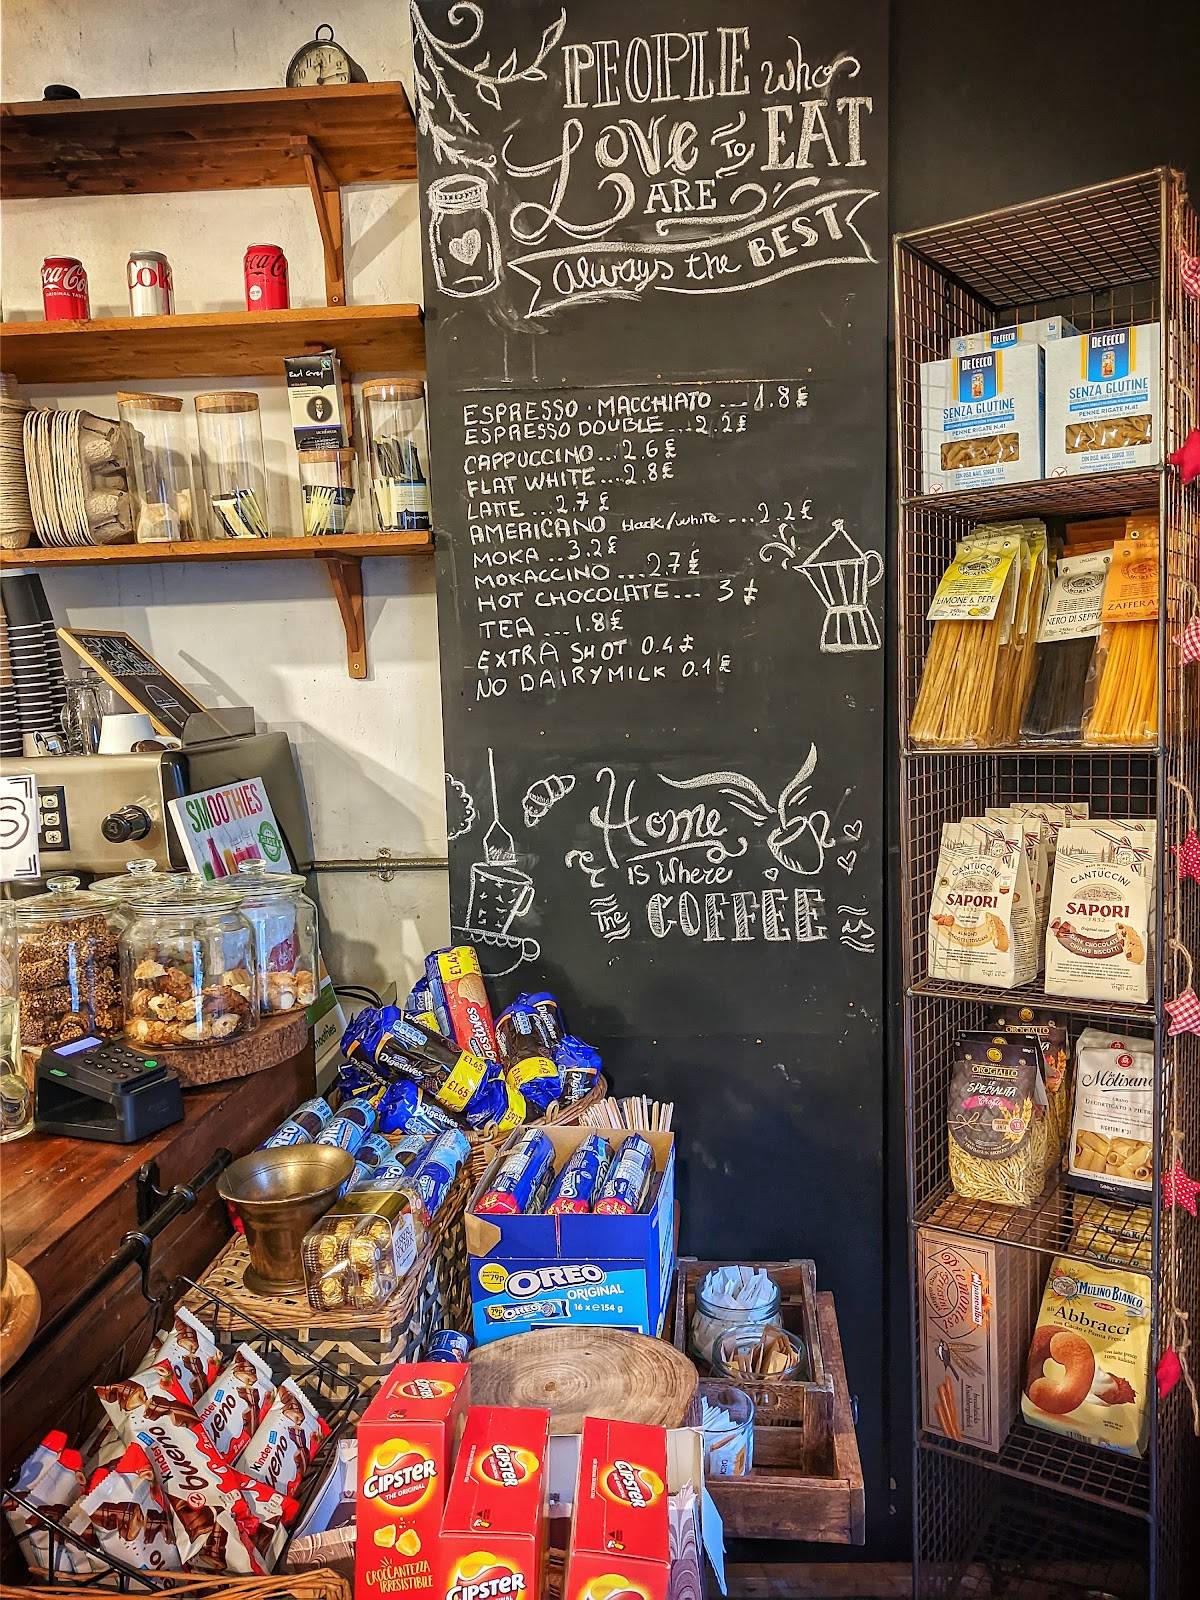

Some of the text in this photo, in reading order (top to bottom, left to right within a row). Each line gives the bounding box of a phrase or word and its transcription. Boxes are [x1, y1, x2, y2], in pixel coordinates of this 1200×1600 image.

[562, 26, 861, 109] PEOPLE who
[723, 138, 748, 159] TO
[760, 96, 873, 172] EAT
[643, 178, 717, 215] ARE
[683, 250, 742, 280] the
[746, 201, 844, 269] BEST
[1069, 384, 1102, 400] SENZA
[1106, 377, 1149, 394] GLUTINE
[463, 399, 579, 426] ESPRESSO
[598, 391, 712, 418] MACCHIATO
[943, 404, 973, 420] SENZA
[976, 397, 1015, 415] GLUTINE
[1101, 406, 1123, 414] RIGATE
[465, 421, 571, 446] ESPRESSO
[578, 415, 665, 437] DOUBLE
[972, 425, 992, 434] RIGATE
[463, 445, 595, 476] CAPPUCCINO
[466, 475, 518, 498] FLAT
[524, 466, 596, 491] WHITE
[469, 515, 606, 546] AMERICANO
[473, 547, 540, 569] MOKA
[474, 564, 610, 590] MOKACCINO
[478, 592, 524, 612] HOT
[535, 583, 669, 607] CHOCOLATE
[937, 596, 968, 605] LIMONE
[1107, 600, 1156, 611] ZAFFERA
[478, 617, 536, 639] TEA
[1046, 616, 1067, 626] NERO
[1068, 614, 1077, 623] DI
[477, 641, 560, 672] EXTRA
[570, 638, 628, 664] SHOT
[476, 677, 508, 701] NO
[185, 783, 263, 833] SMOOTHIES
[588, 766, 730, 869] Home
[657, 857, 735, 888] Where
[952, 862, 1001, 879] CANTUCCINI
[1070, 870, 1131, 887] CANTUCCINI
[946, 893, 998, 908] SAPORI
[1066, 902, 1130, 918] SAPORI
[590, 907, 630, 935] The
[646, 887, 829, 943] COFFEE
[379, 1053, 425, 1078] Digestives
[464, 1055, 485, 1072] £1.65
[971, 1065, 1018, 1078] OROGIALLO
[447, 1082, 469, 1099] £1.65
[422, 1103, 459, 1128] Digestives
[270, 1125, 299, 1149] REO
[506, 1265, 606, 1299] OREO
[566, 1284, 625, 1300] ORIGINAL
[941, 1252, 969, 1333] Piemontesi
[1080, 1282, 1143, 1308] MULINO BIANCO
[503, 1303, 541, 1320] OREO
[1055, 1306, 1131, 1335] Abbracci
[151, 1445, 174, 1485] Kinder
[249, 1443, 274, 1473] Kinder
[492, 1444, 520, 1487] CIPSTER
[362, 1459, 438, 1500] CIPSTER
[385, 1483, 426, 1501] THE ORIGINAL
[613, 1459, 648, 1510] CIPSTER
[365, 1559, 431, 1588] CROCCANTEZZA
[379, 1574, 434, 1594] IRRESISTIBILE
[444, 1572, 526, 1600] CIPSTER
